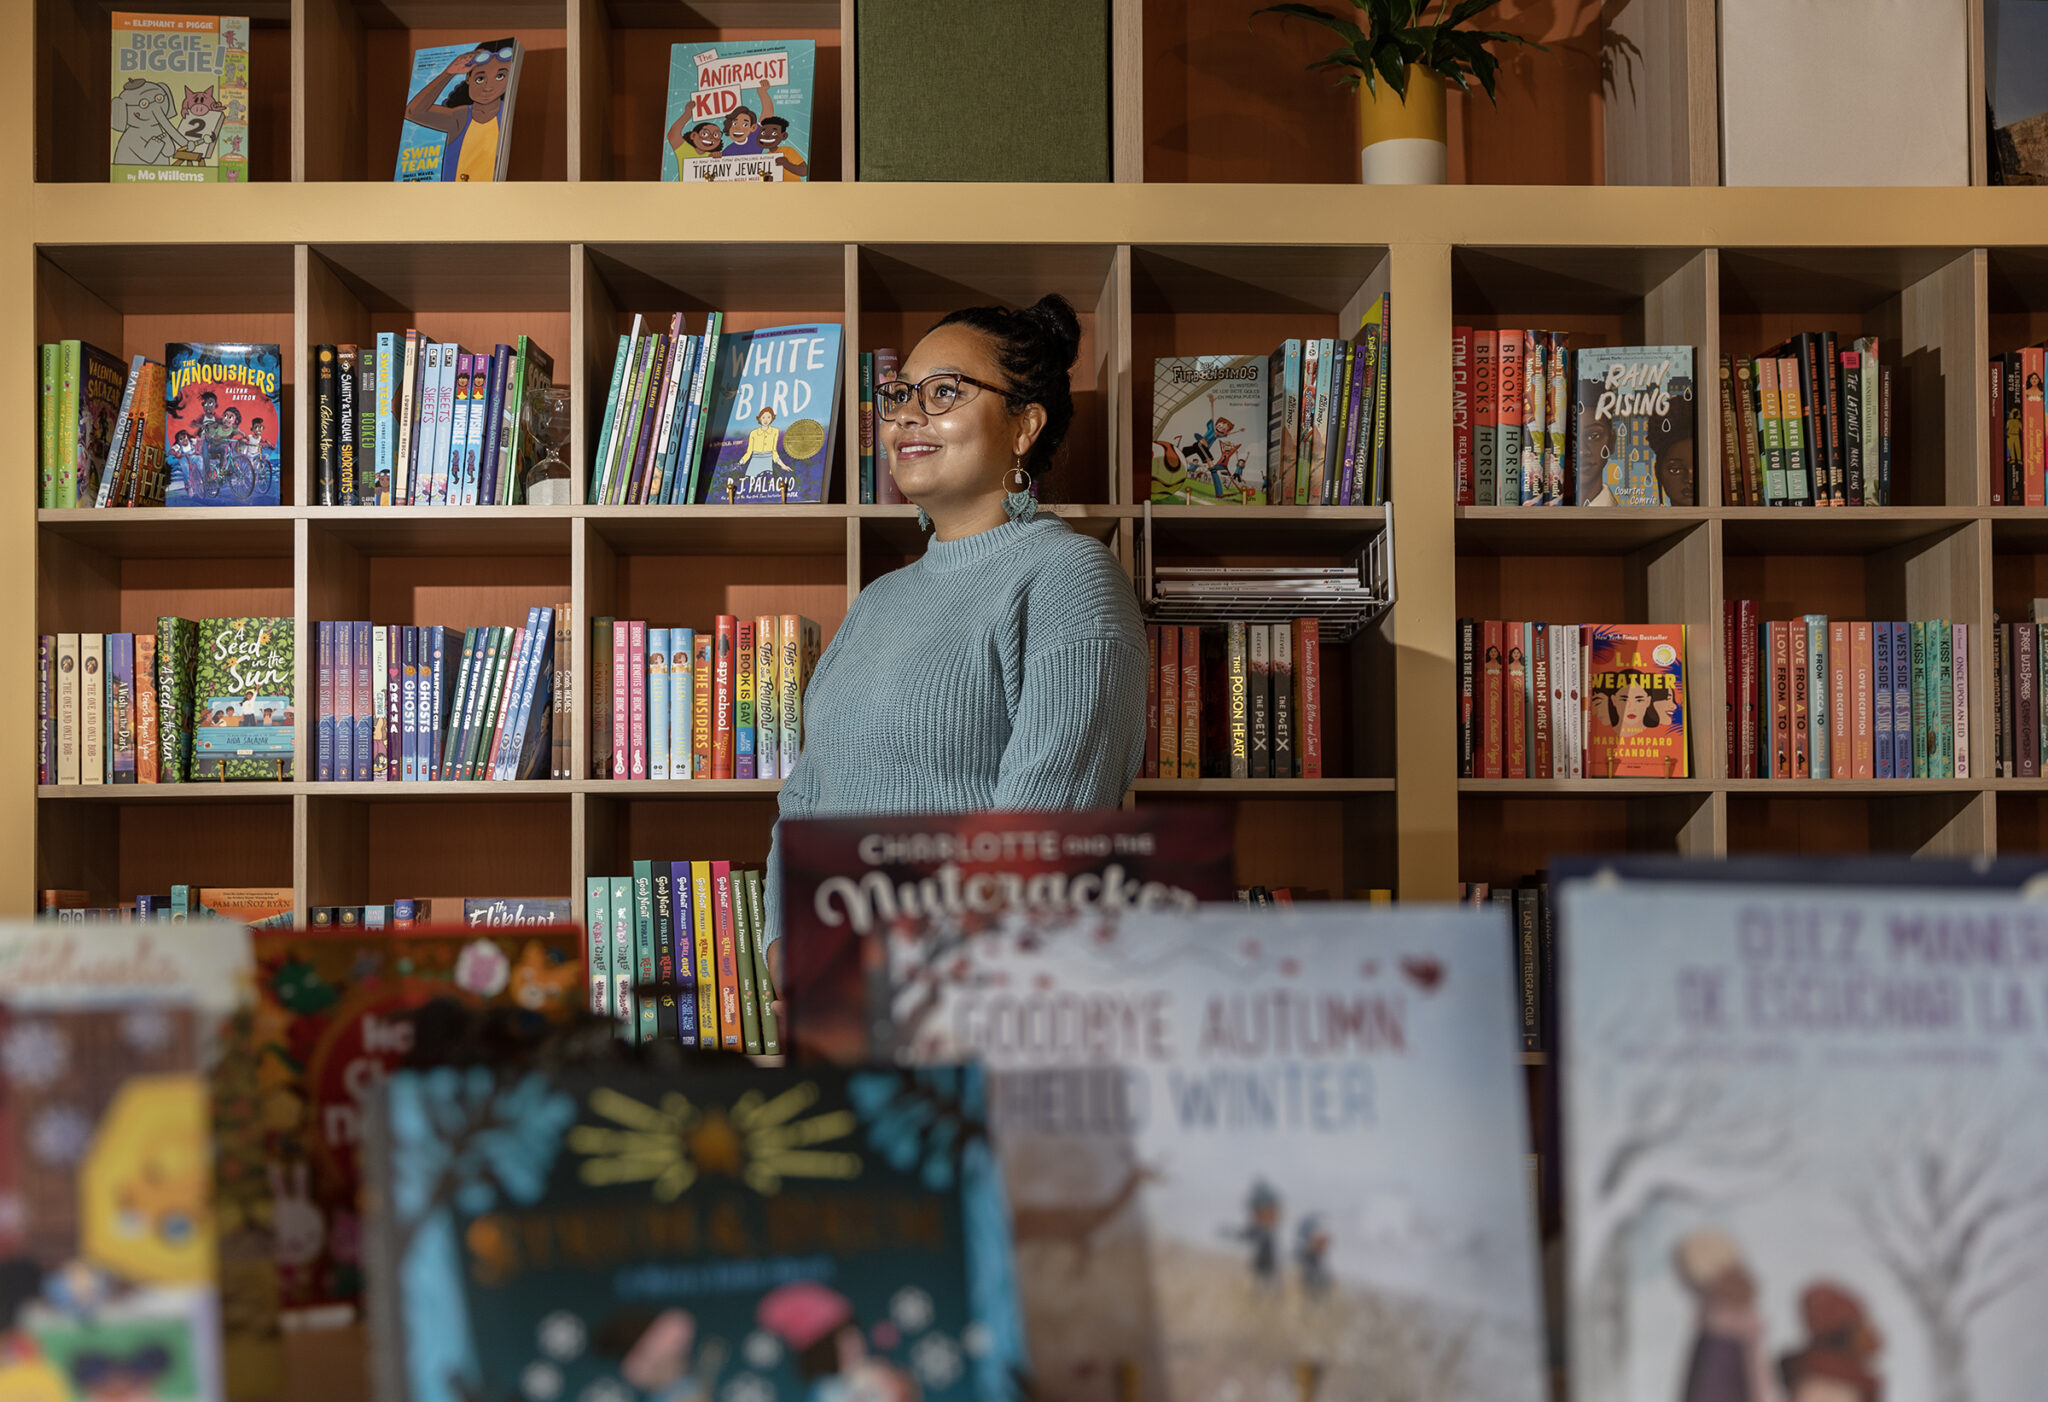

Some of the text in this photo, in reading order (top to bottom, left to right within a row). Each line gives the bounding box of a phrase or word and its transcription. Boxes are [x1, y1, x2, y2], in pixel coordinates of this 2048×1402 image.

[131, 32, 211, 50] BIGGIE-
[133, 19, 175, 28] ELEPHANT
[186, 21, 213, 30] PIGGIE
[120, 45, 226, 76] BIGGIE!
[697, 54, 713, 63] The
[699, 58, 787, 88] ANTIRACIST
[695, 90, 738, 118] KID
[184, 118, 207, 138] 2
[400, 157, 439, 173] TEAM
[401, 145, 441, 160] SWIM
[693, 161, 773, 179] TIFFANY JEWELL
[138, 170, 156, 181] Mo
[157, 170, 204, 182] Willems
[182, 360, 196, 368] THE
[732, 338, 825, 378] WHITE
[1452, 336, 1466, 368] TOM
[1535, 344, 1543, 367] Sarah
[171, 362, 276, 397] VANQUISHERS
[613, 356, 624, 386] HOLLOW
[1476, 344, 1489, 414] BROOKS
[1502, 344, 1516, 413] BROOKS
[1604, 360, 1671, 390] RAIN
[115, 371, 140, 440] BAN BOOK
[422, 386, 436, 424] SHEETS
[438, 386, 452, 423] SHEETS
[735, 378, 812, 421] BIRD
[1452, 370, 1468, 430] CLANCY
[1594, 388, 1671, 421] RISING
[320, 404, 333, 438] Golden
[361, 412, 375, 449] BOOKED
[454, 404, 468, 445] INVISIBLE
[1847, 373, 1860, 490] THE LATINIST MARK PRINS
[320, 438, 333, 461] Hour
[1480, 432, 1492, 486] HORSE
[1505, 431, 1518, 485] HORSE
[1787, 392, 1803, 497] CLAP WHEN YOU LAND
[1460, 458, 1468, 493] WINTER
[1532, 472, 1541, 496] Could
[214, 629, 264, 661] Seed
[234, 628, 244, 641] A
[1795, 634, 1804, 664] LOVE
[228, 654, 289, 694] Sun
[251, 650, 285, 667] in the
[740, 625, 751, 724] THIS BOOK IS GAY
[1615, 652, 1648, 668] L.A.
[2019, 626, 2032, 700] JORGE LUIS BORGES
[359, 669, 369, 687] WHEN
[1592, 673, 1676, 690] WEATHER
[1795, 667, 1805, 702] FROM
[1815, 628, 1825, 762] LOVE FROM MECCA TO MEDINA
[1876, 632, 1892, 732] WEST SIDE LOVE STORY
[1940, 640, 1951, 725] KISS ME, CATALINA
[359, 690, 369, 710] STARS
[390, 682, 398, 734] DRAMA
[404, 680, 415, 734] GHOSTS
[420, 680, 430, 734] GHOSTS
[696, 666, 708, 749] THE INSIDERS
[716, 661, 730, 731] spy school
[1183, 665, 1198, 756] WITH FIRE HIGH
[1230, 656, 1246, 759] THIS POISON HEART
[1796, 704, 1805, 712] A
[1956, 656, 1965, 738] ONCE UPON AN EID
[88, 682, 96, 757] THE ONE AND ONLY BOB
[138, 691, 156, 760] Genesis Begins Again
[160, 666, 176, 762] A Seed in the Sun
[1796, 715, 1806, 730] TO
[359, 726, 369, 760] SCATTERED
[1276, 738, 1289, 751] X
[857, 830, 1156, 866] CHARLOTTE AND THE
[212, 898, 291, 908] PAM MUÑOZ RYAN
[470, 904, 556, 928] Elephant
[494, 901, 507, 912] The
[1523, 910, 1534, 1026] LAST NIGHT TELEGRAPH CLUB
[953, 990, 1409, 1062] GOODBYE AUTUMN
[1001, 1061, 1380, 1136] HELLO WINTER
